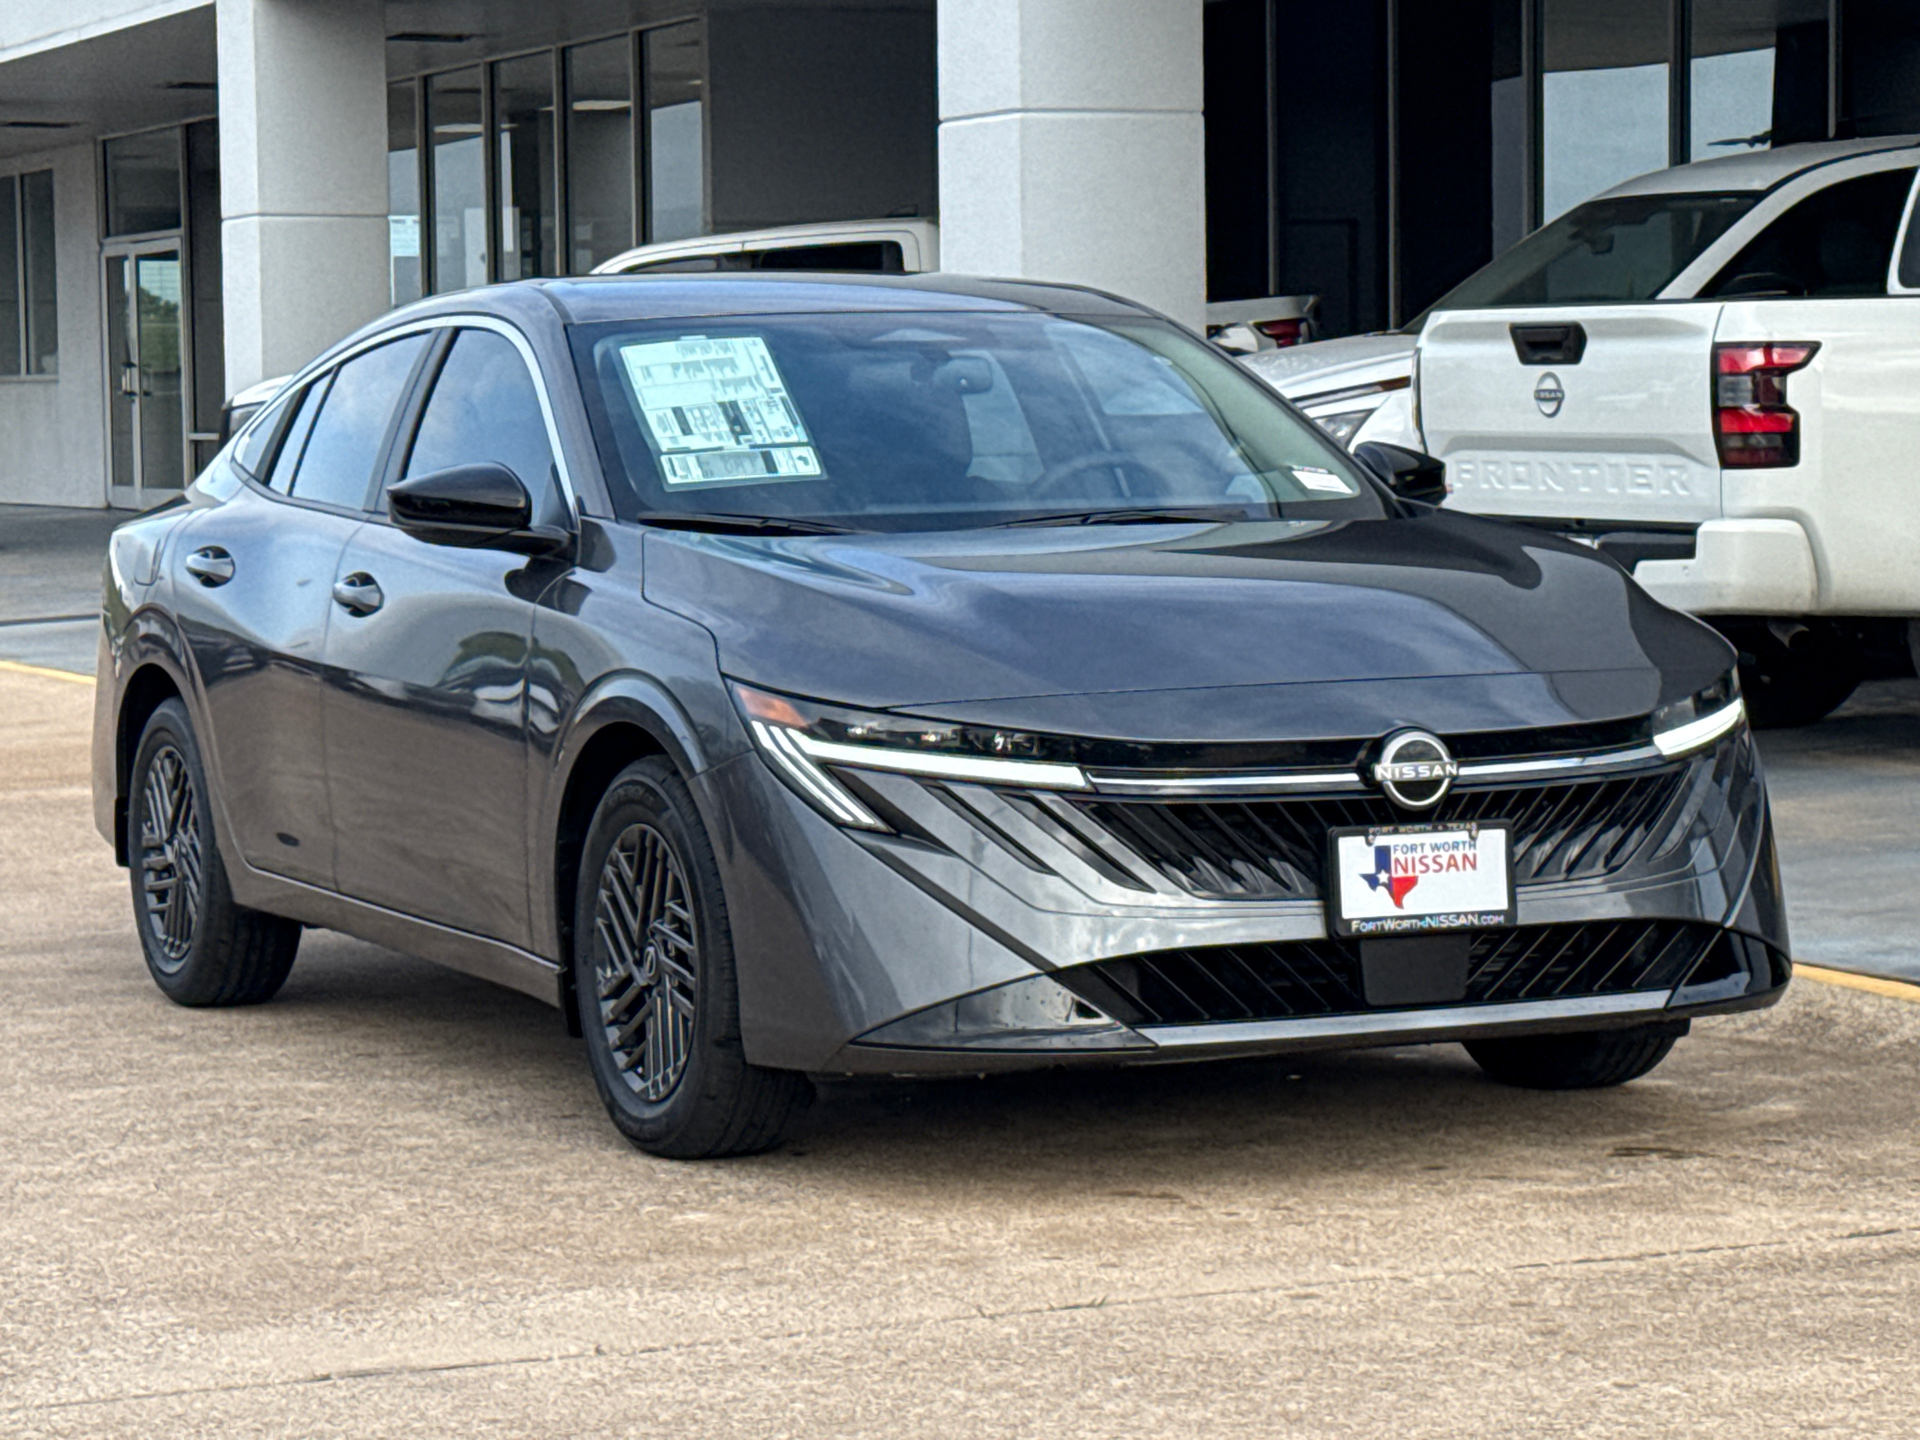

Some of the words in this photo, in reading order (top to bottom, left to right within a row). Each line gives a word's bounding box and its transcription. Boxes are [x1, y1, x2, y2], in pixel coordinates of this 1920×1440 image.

[1453, 461, 1690, 495] FRONTIER
[1377, 763, 1457, 780] NISSAN
[1368, 826, 1394, 834] FORT
[1398, 824, 1433, 833] WORTH
[1448, 822, 1477, 831] TEXAS
[1393, 842, 1426, 855] FORT
[1430, 840, 1477, 854] WORTH
[1393, 852, 1478, 874] NISSAN
